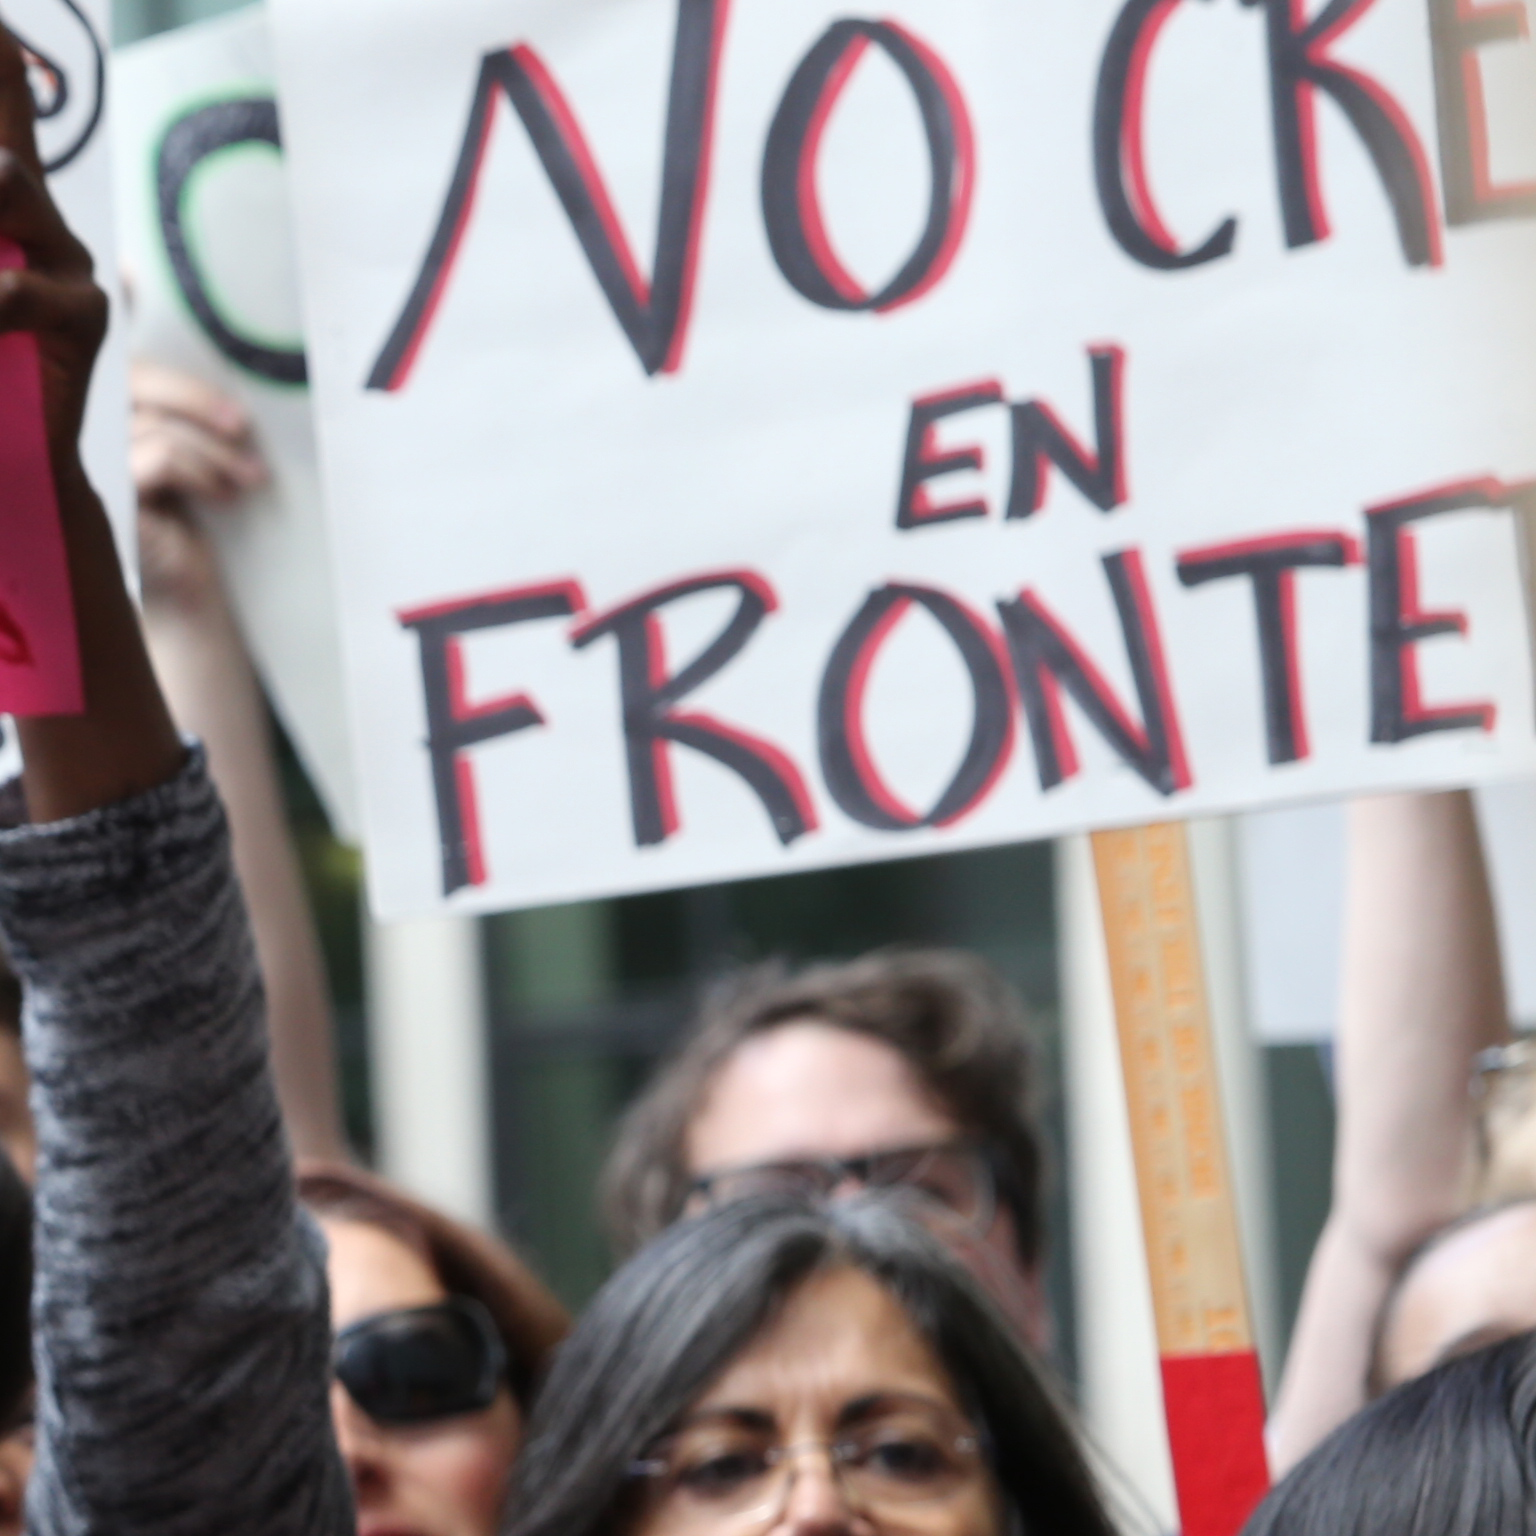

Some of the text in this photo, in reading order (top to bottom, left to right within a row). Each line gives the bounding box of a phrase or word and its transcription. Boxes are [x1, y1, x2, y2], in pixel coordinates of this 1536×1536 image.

[362, 0, 978, 393] NO
[893, 342, 1129, 532] EN
[395, 472, 1536, 899] FRONTE
